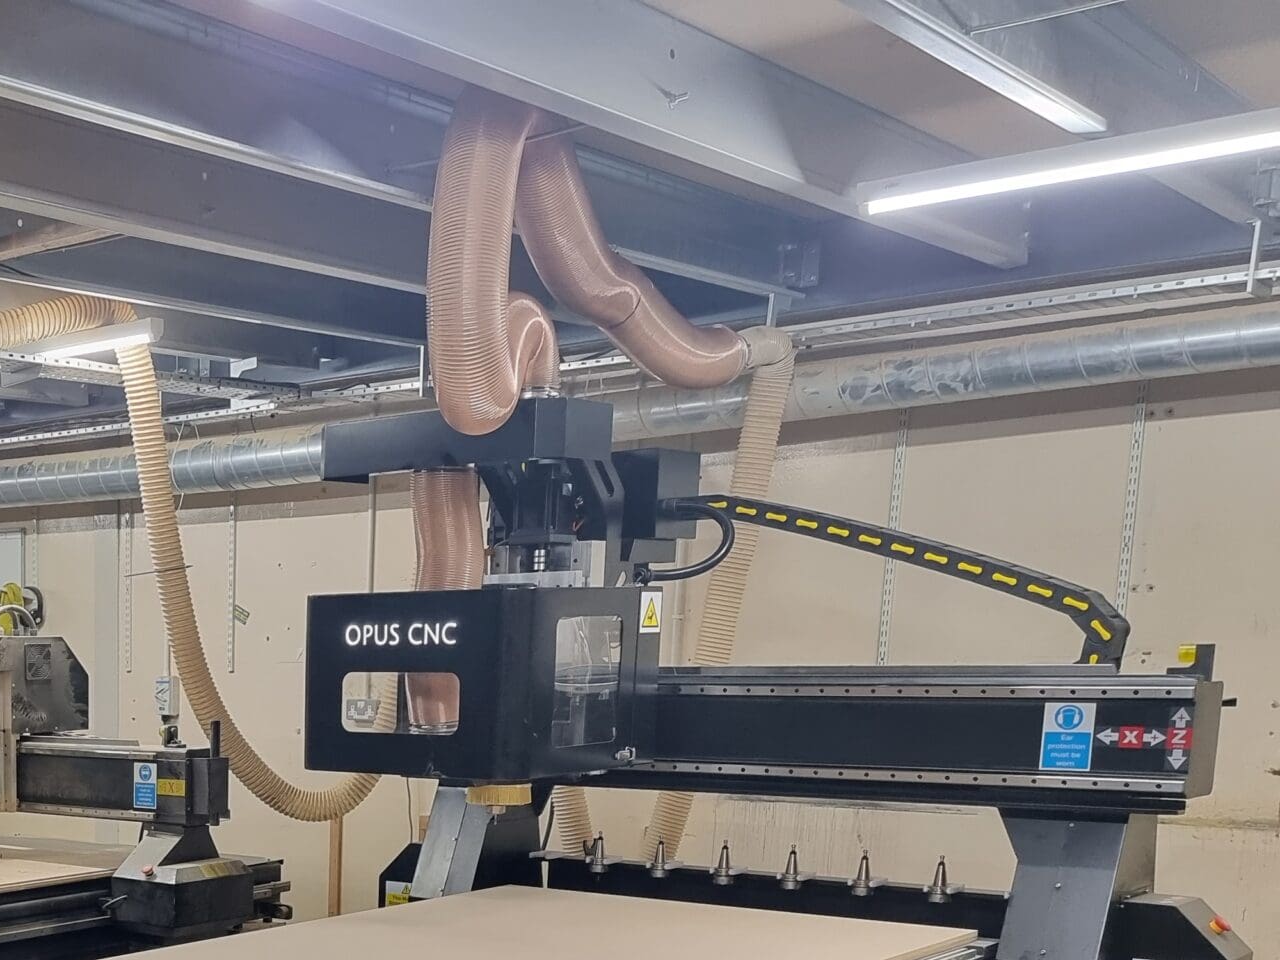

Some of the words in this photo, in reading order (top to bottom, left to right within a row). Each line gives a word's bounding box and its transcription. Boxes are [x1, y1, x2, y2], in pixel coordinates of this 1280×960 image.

[345, 623, 400, 646] OPUS
[407, 622, 457, 645] CNC
[1121, 730, 1140, 744] X
[1170, 729, 1187, 744] Z
